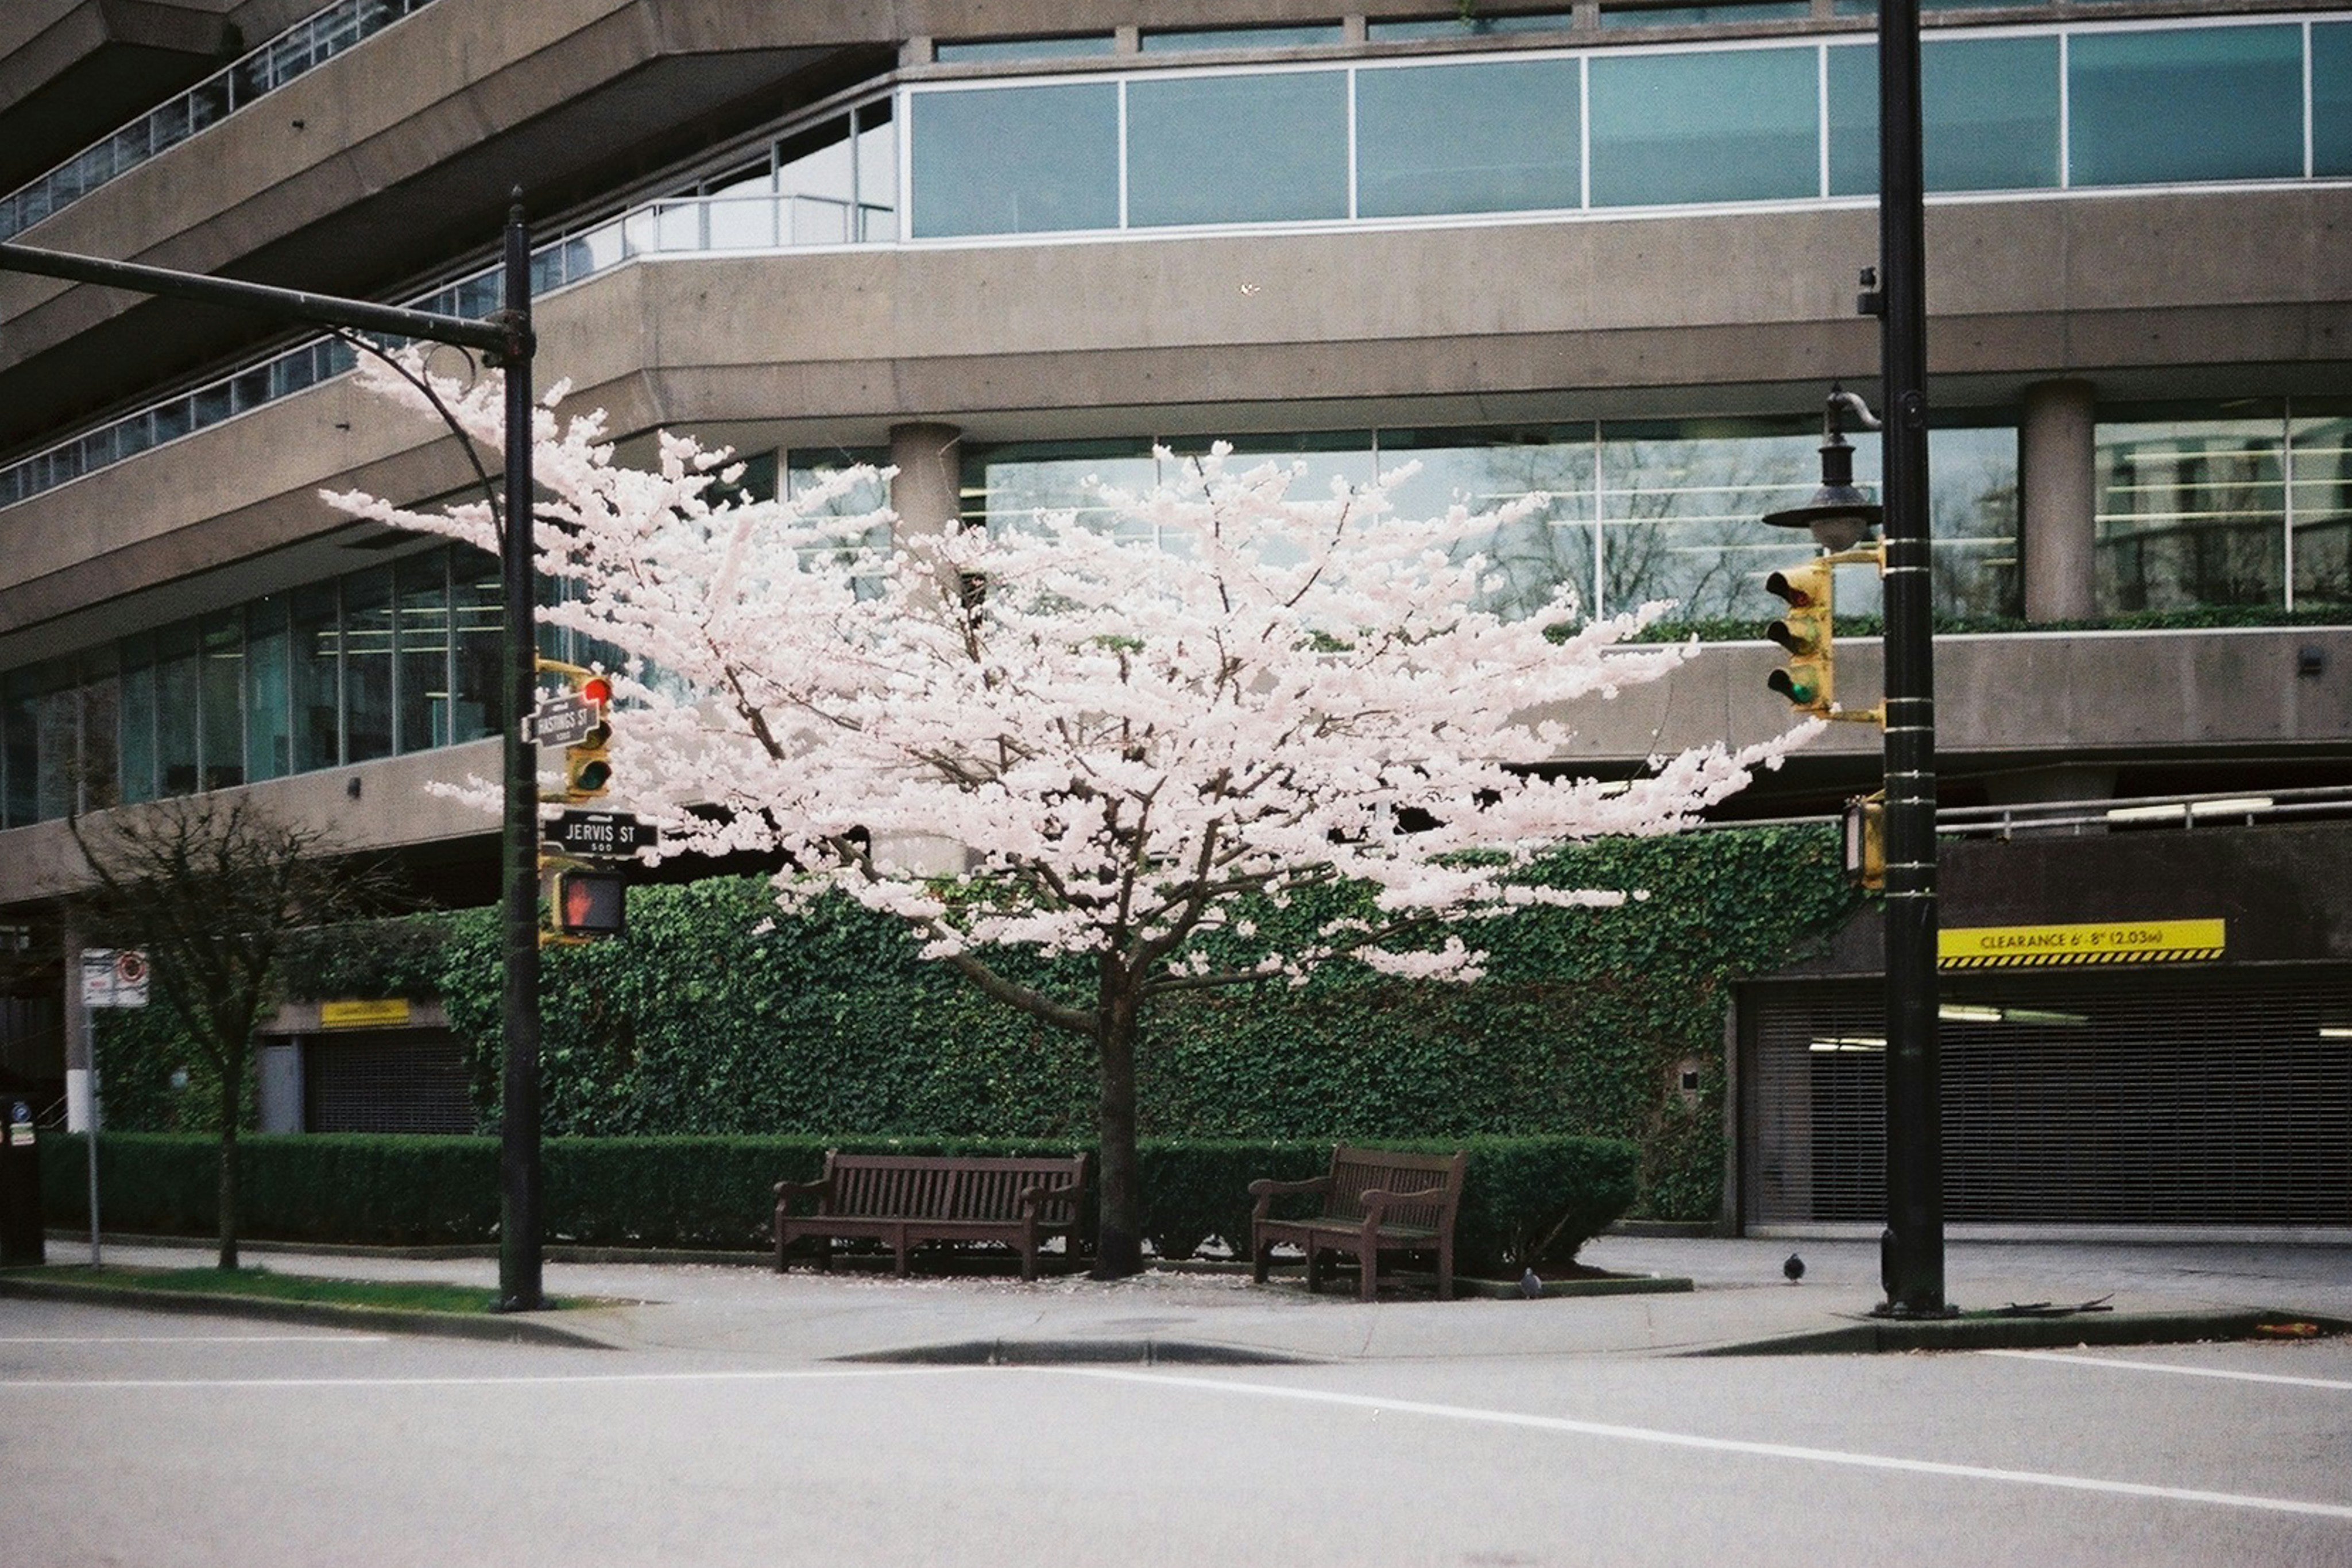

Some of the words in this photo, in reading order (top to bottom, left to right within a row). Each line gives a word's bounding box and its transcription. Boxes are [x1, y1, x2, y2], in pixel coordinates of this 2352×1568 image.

[578, 708, 587, 726] ST
[566, 824, 614, 842] JERVIS
[620, 826, 635, 842] ST
[591, 843, 612, 851] 500
[1980, 934, 2066, 948] CLEARANCE
